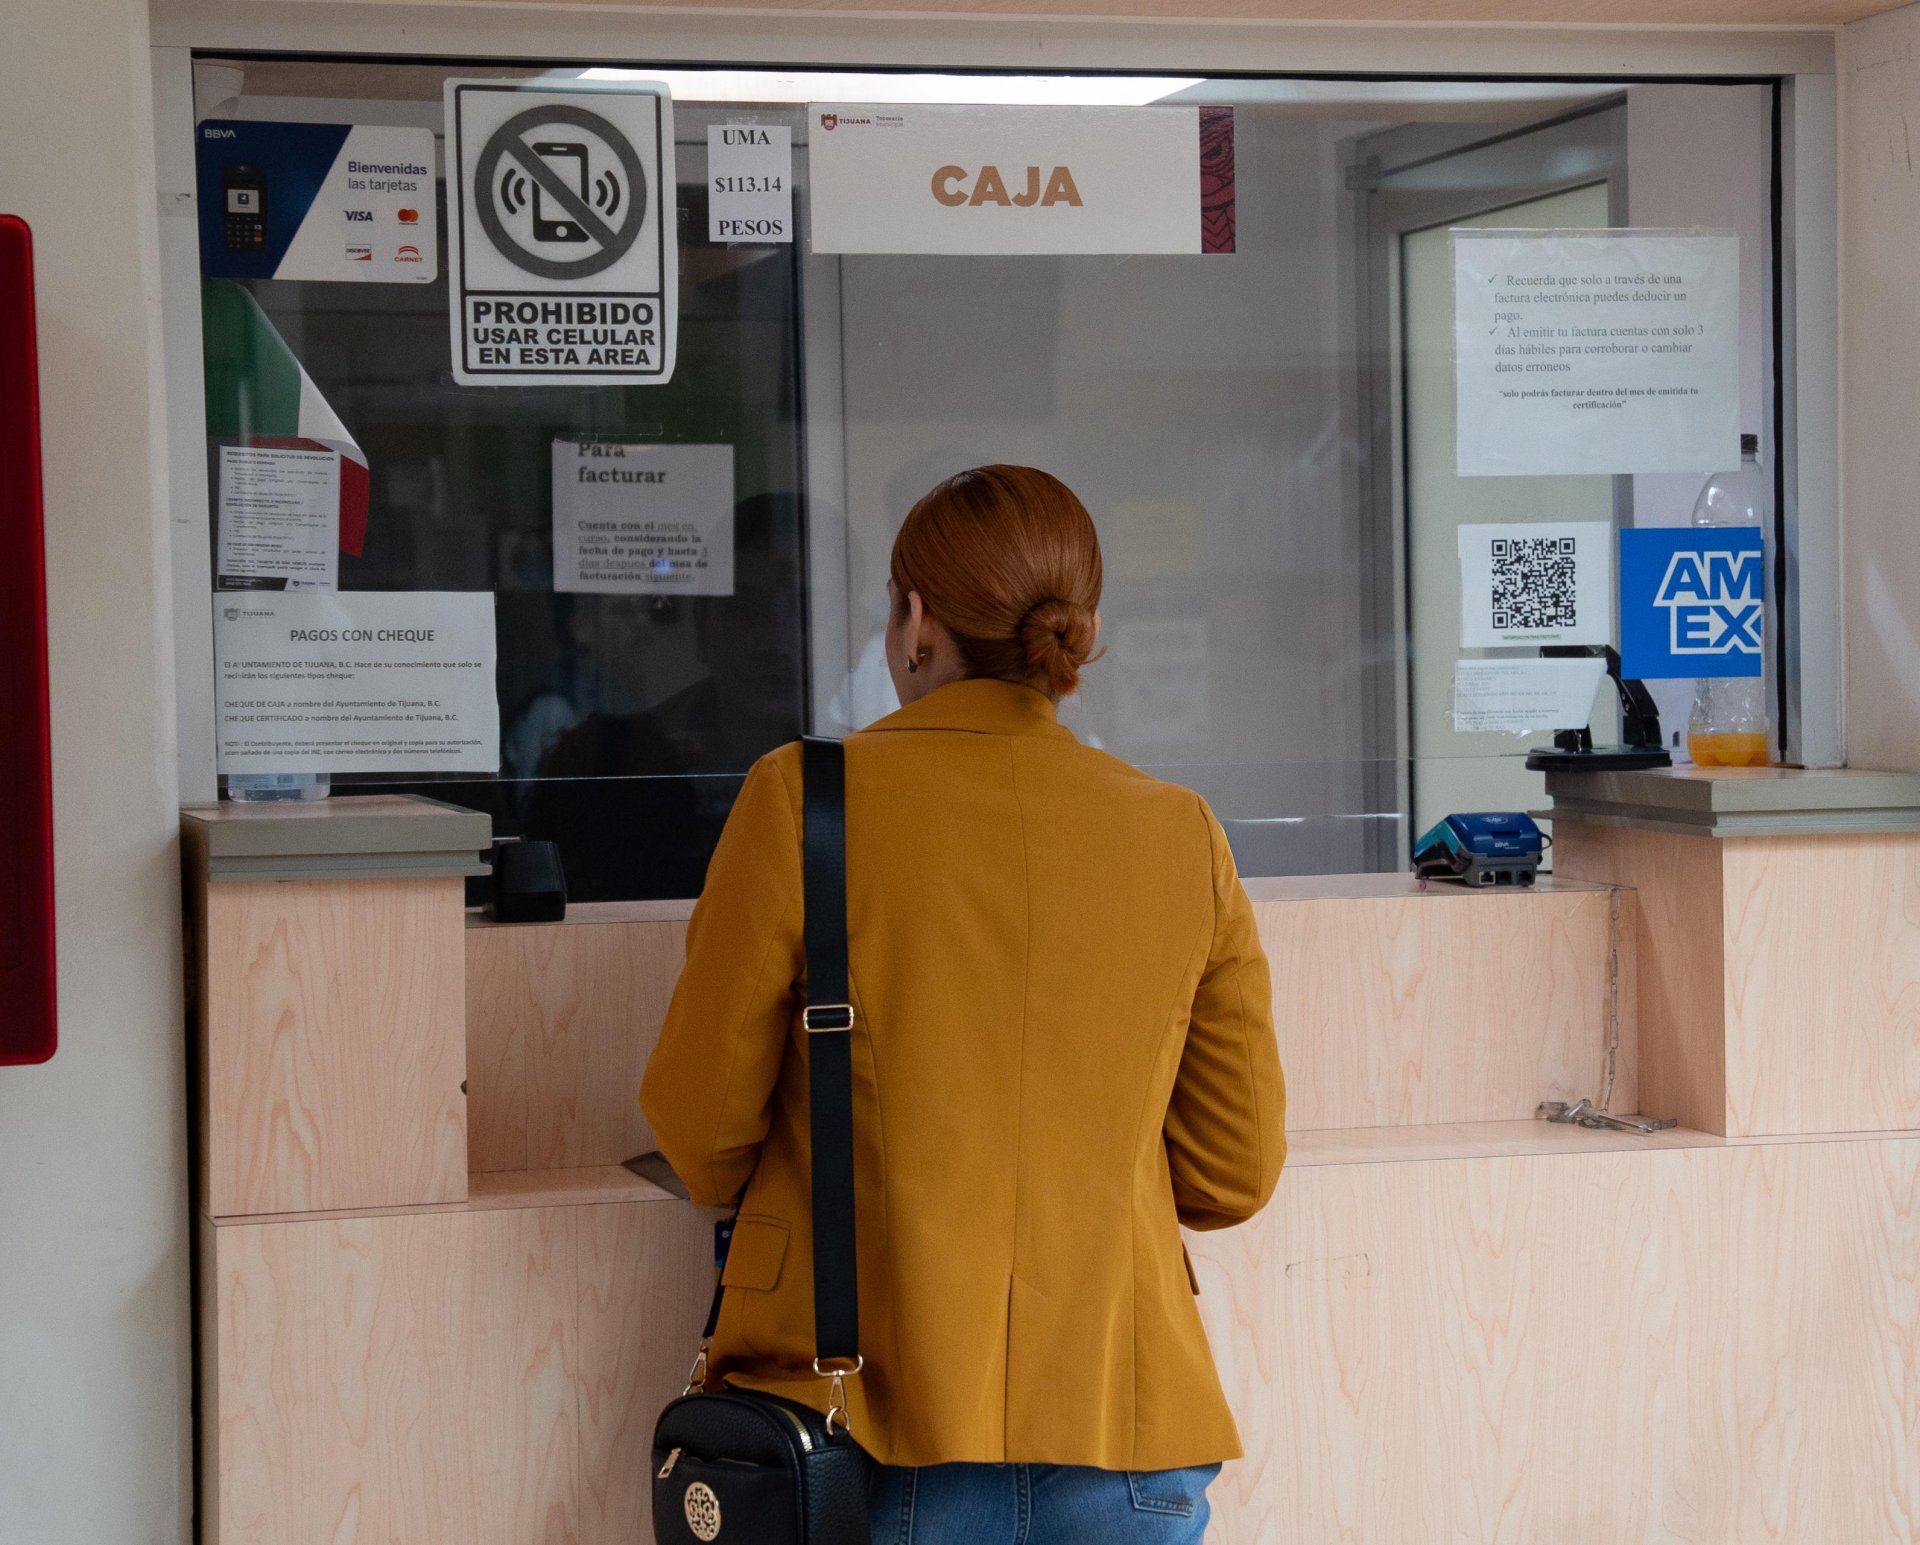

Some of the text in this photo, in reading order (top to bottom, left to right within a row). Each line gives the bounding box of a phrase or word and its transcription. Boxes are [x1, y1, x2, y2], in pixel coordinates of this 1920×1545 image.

[204, 128, 236, 139] BBVA
[723, 129, 771, 146] UMA
[348, 161, 428, 176] Bienvenidas
[348, 178, 417, 193] las tarjetas
[715, 176, 782, 193] $113.14
[931, 165, 1084, 207] CAJA
[344, 210, 373, 222] VISA
[718, 219, 783, 236] PESOS
[1506, 274, 1682, 287] Recuerda que solo a través de una
[1494, 291, 1687, 305] factura electrónica puedes deducir un
[473, 301, 654, 326] PROHIBIDO
[1494, 311, 1523, 323] pago.
[473, 328, 655, 346] USAR CELULAR
[1507, 325, 1704, 338] Al emitir tu factura cuentas con solo 3
[479, 347, 651, 365] EN ESTA AREA
[1519, 344, 1556, 355] hábiles
[1559, 346, 1582, 357] para
[1584, 343, 1639, 354] corroborar
[1642, 345, 1649, 353] o
[1651, 342, 1693, 353] cambiar
[1495, 361, 1571, 373] datos erróneos
[1521, 389, 1549, 399] podrás
[1551, 389, 1585, 397] facturar
[1586, 389, 1613, 397] dentro
[1615, 388, 1628, 396] del
[1646, 388, 1657, 396] de
[1658, 387, 1688, 396] emitida
[578, 443, 626, 457] Para
[578, 466, 667, 483] facturar
[578, 521, 617, 530] Cuenta
[621, 522, 640, 530] con
[644, 522, 654, 530] el
[614, 534, 688, 543] considerando
[691, 534, 701, 543] la
[579, 546, 608, 555] fecha
[611, 547, 624, 555] de
[628, 548, 654, 557] pago
[657, 547, 664, 556] y
[668, 546, 697, 556] hasta
[695, 559, 708, 568] de
[579, 571, 641, 580] facturación
[290, 629, 435, 643] PAGOS CON CHEQUE
[304, 661, 336, 669] TIJUANA,
[269, 672, 305, 680] siguientes
[307, 672, 324, 680] tipos
[335, 701, 386, 709] Ayuntamiento
[399, 700, 426, 708] Tijuana,
[416, 714, 443, 722] Tijuana,
